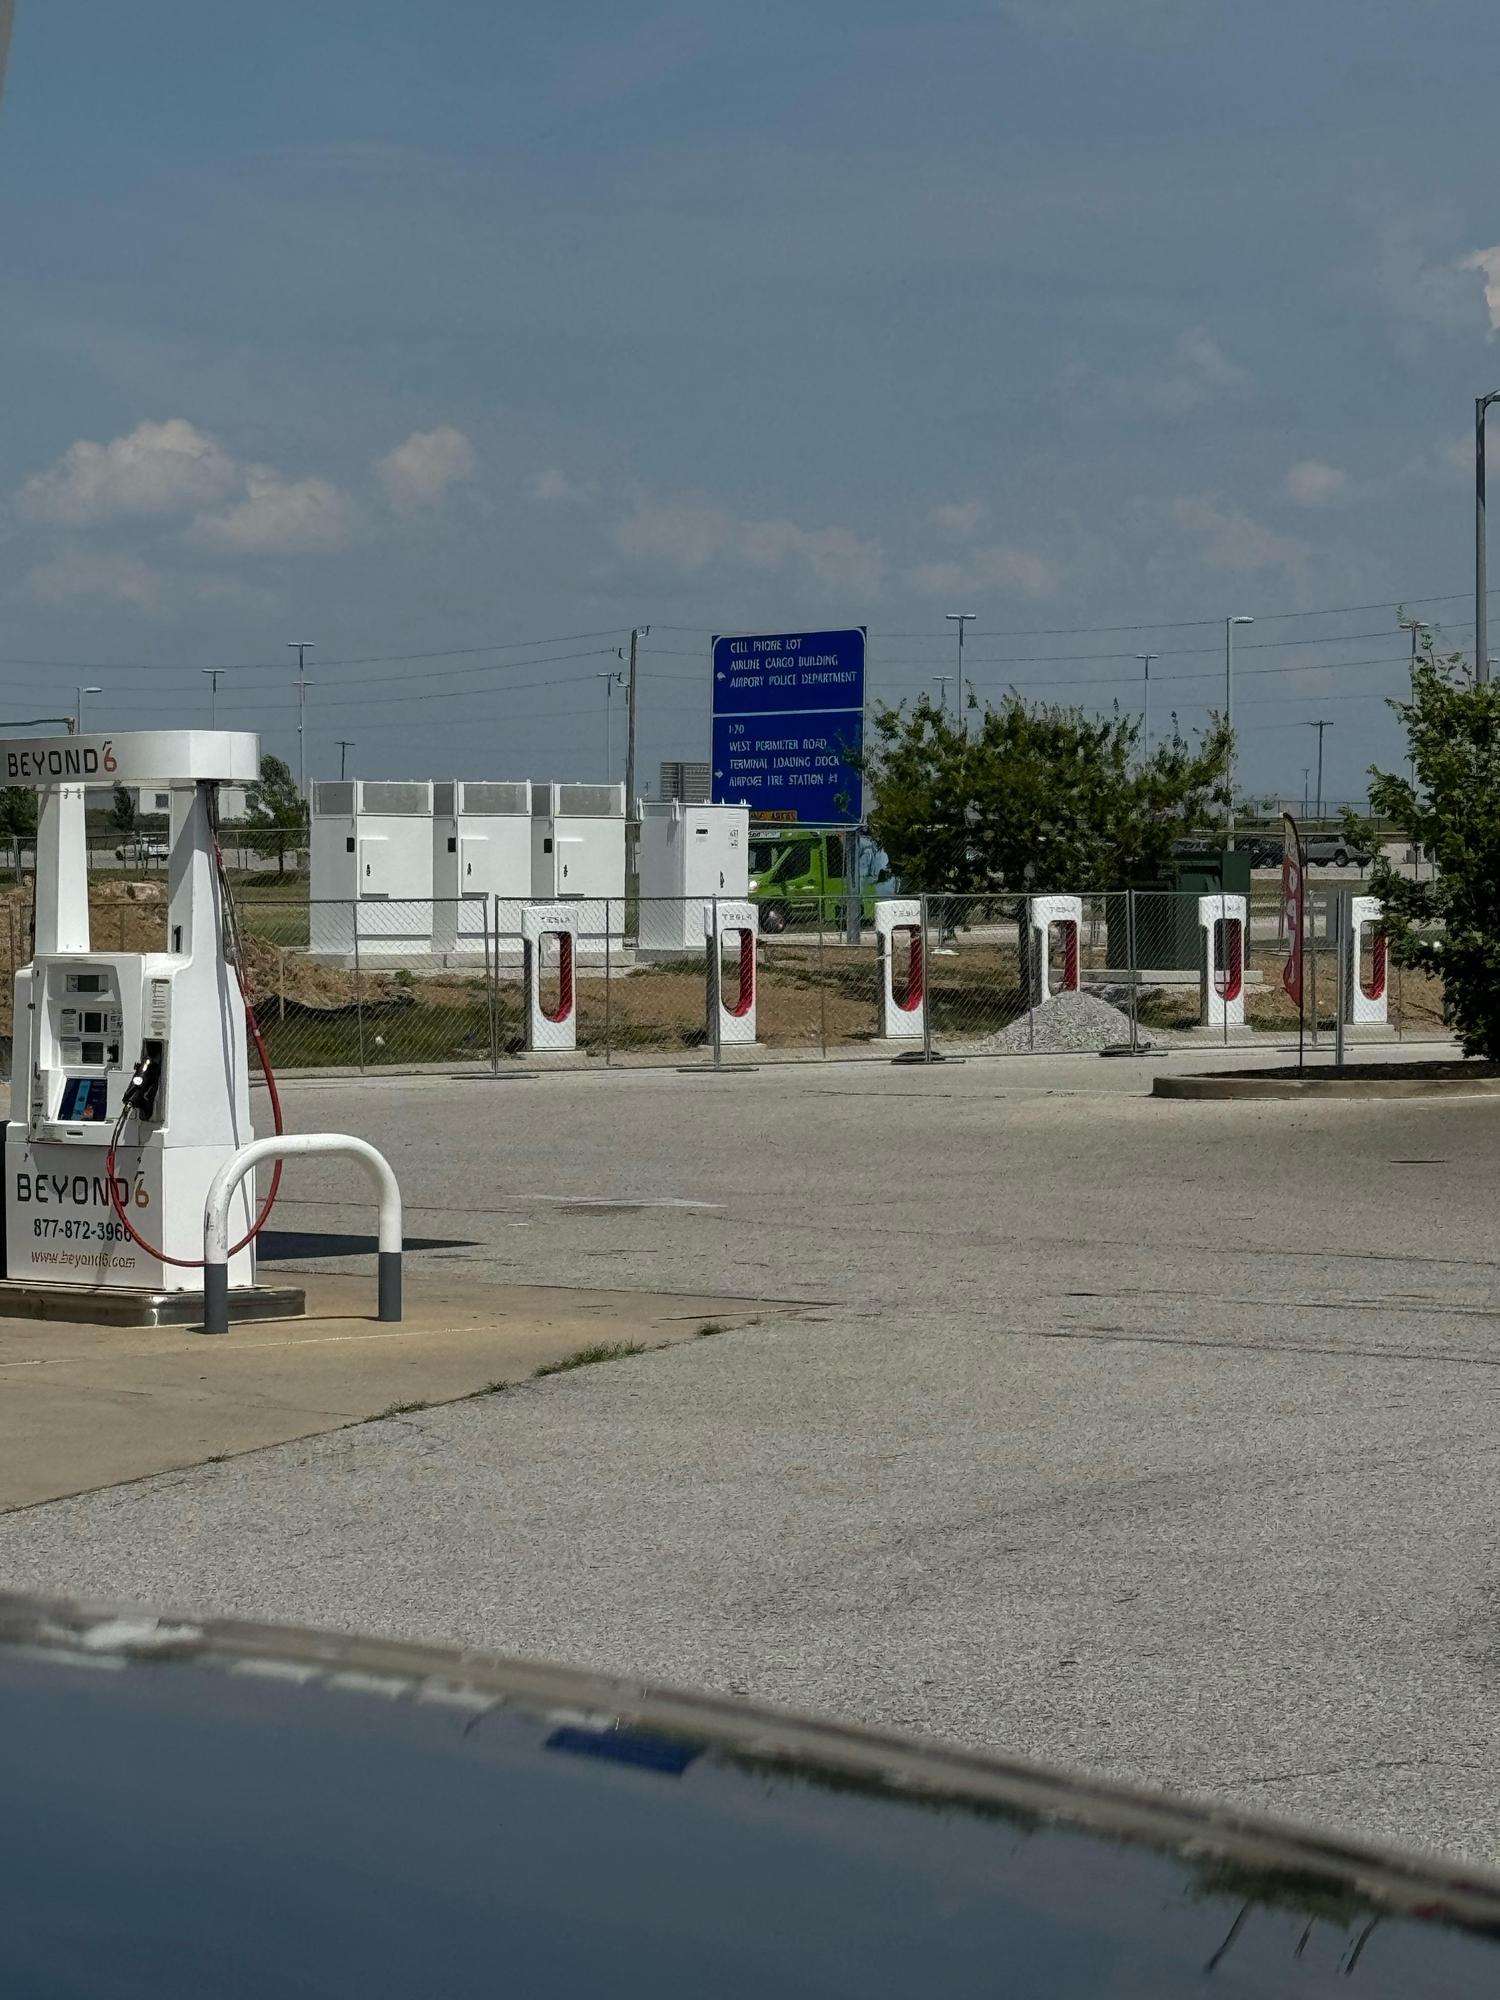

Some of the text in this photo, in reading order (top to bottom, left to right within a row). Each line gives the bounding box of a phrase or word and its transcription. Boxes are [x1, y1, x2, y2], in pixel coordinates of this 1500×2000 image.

[786, 639, 802, 650] LOT
[730, 655, 839, 671] AIRLINE CARGO BUILDING
[730, 671, 857, 688] AIRPORT POLICE DEPARTMENT
[729, 738, 827, 752] WEST PERIMETER ROAD
[730, 755, 840, 769] TERMINAL LOADING DOCK
[767, 775, 784, 786] FIRE
[788, 773, 823, 785] STATION
[721, 912, 752, 921] TESLA
[173, 924, 182, 954] 1
[33, 1218, 133, 1242] 877-872-3966
[31, 1250, 136, 1269] www.beyond6.com
